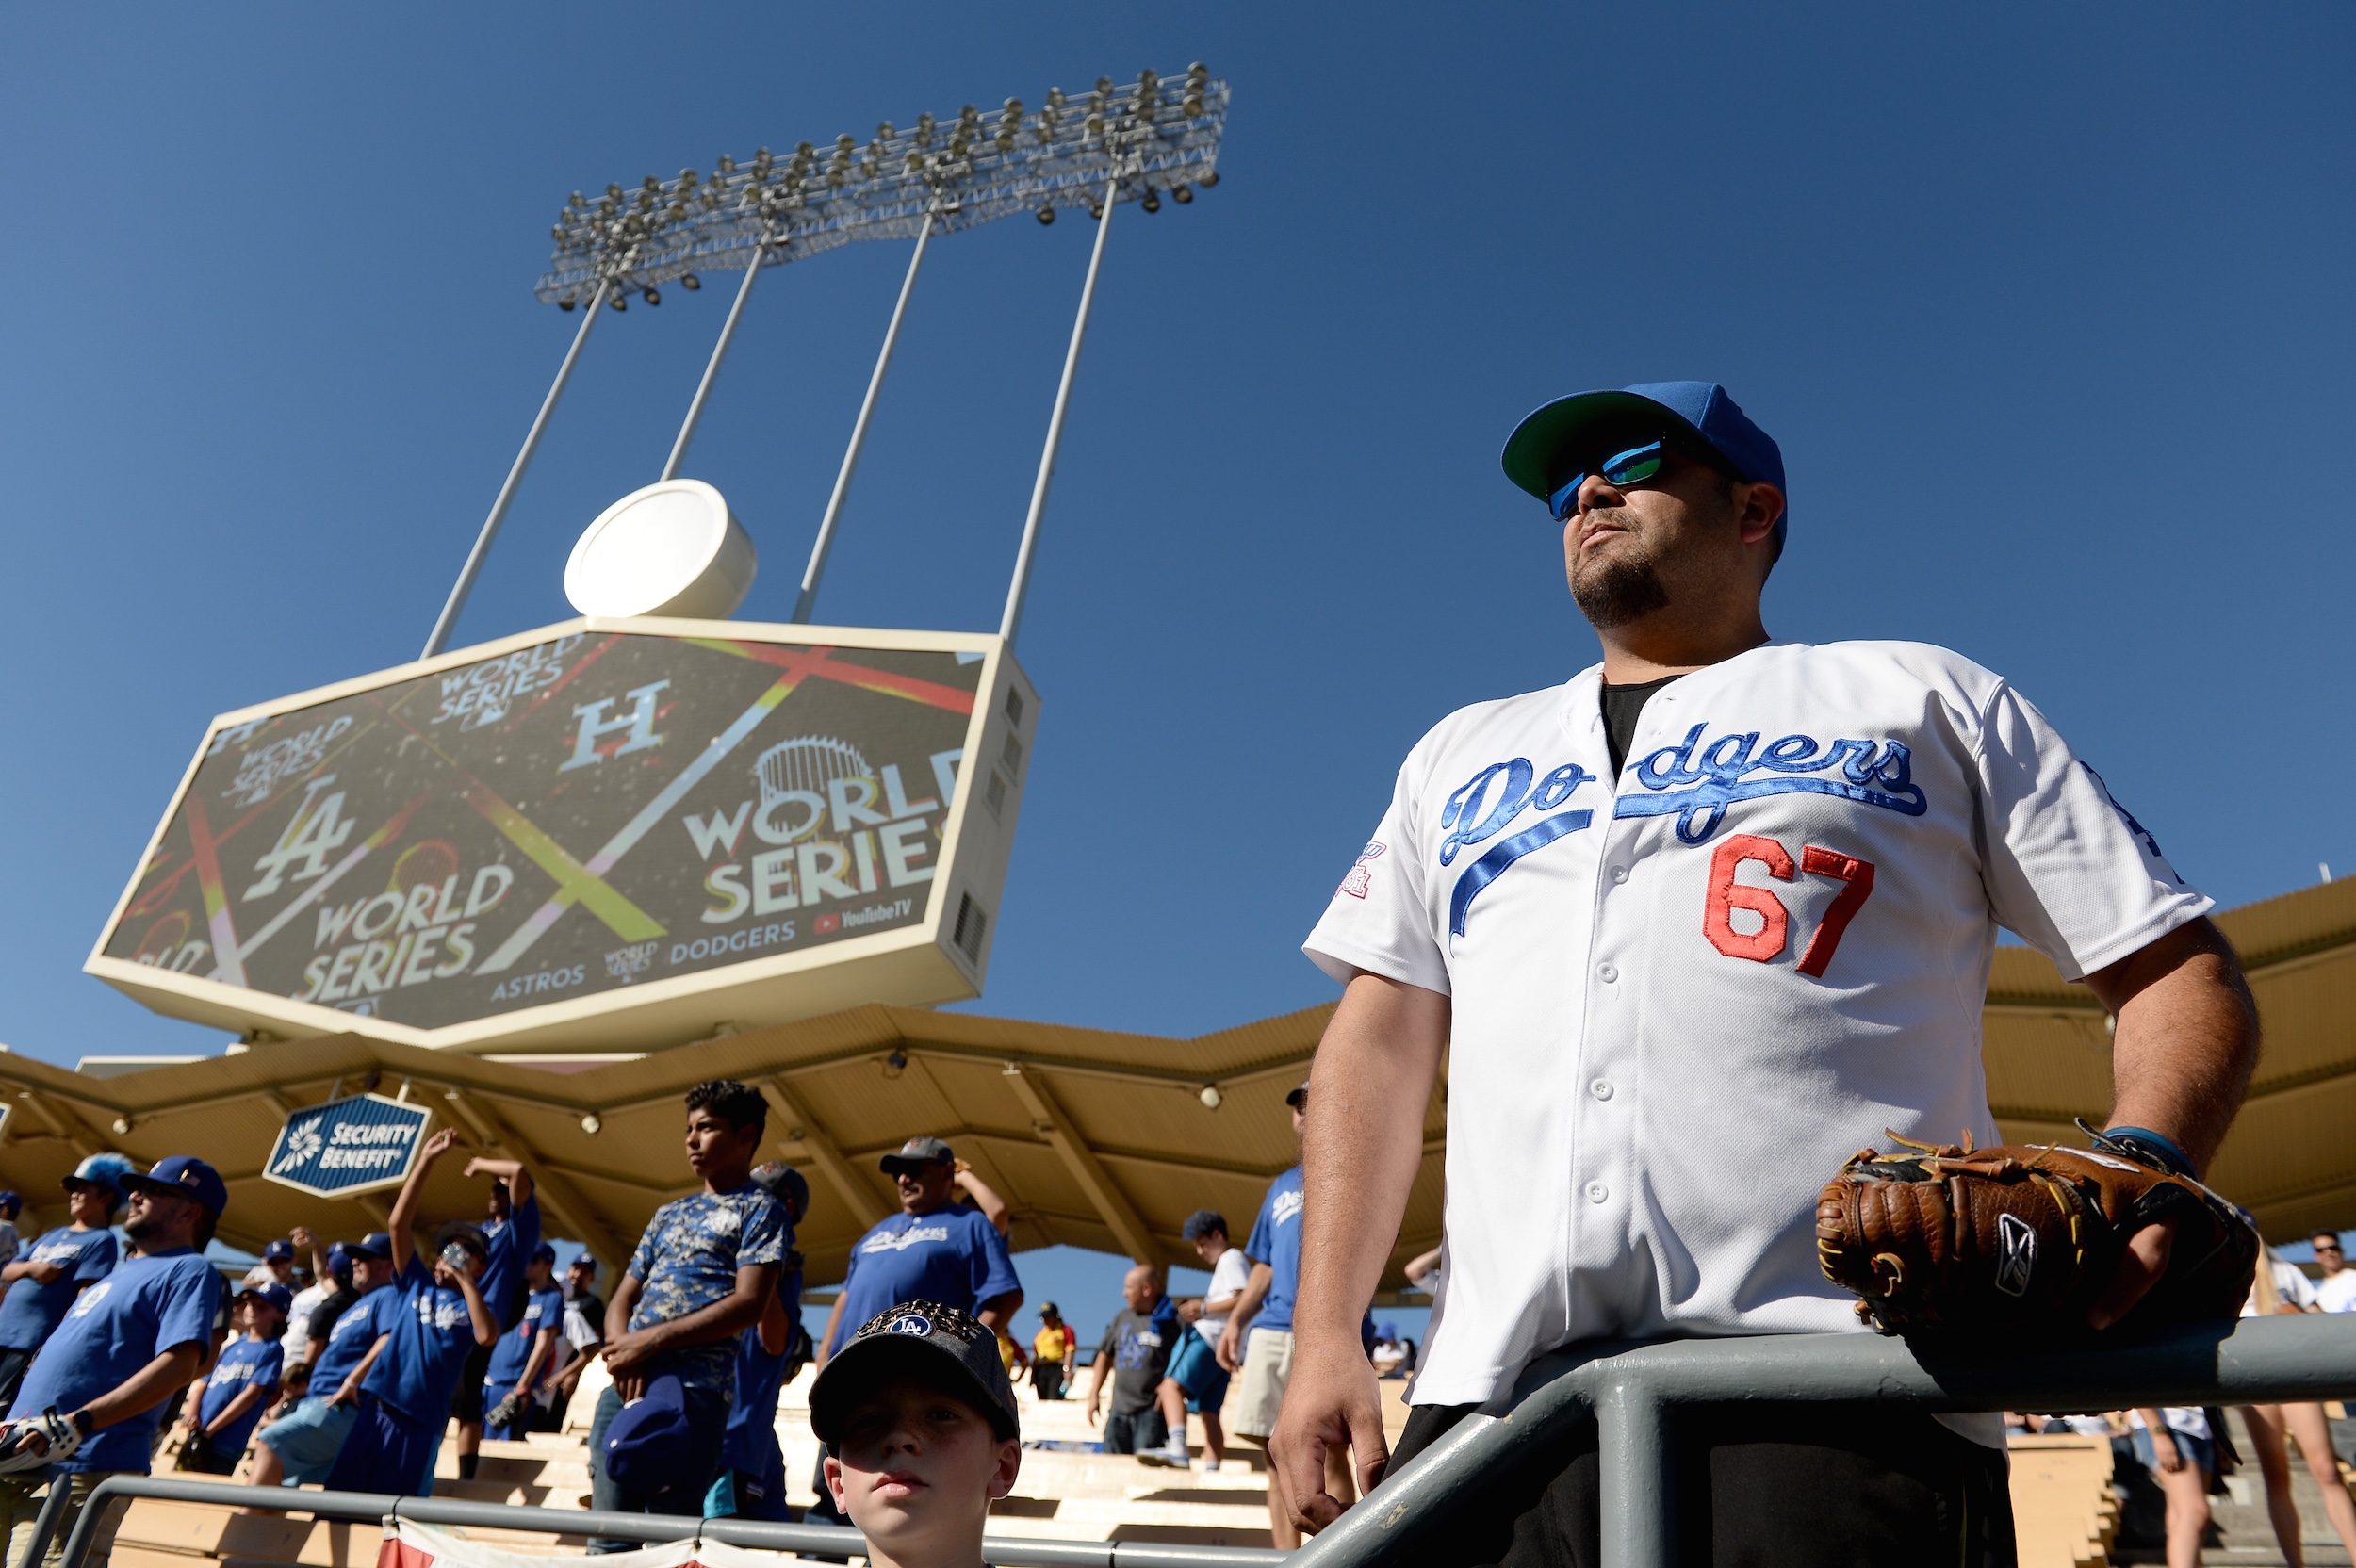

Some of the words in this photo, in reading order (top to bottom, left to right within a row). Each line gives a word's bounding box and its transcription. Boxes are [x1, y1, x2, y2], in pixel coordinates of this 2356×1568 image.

[430, 659, 564, 726] SERIES
[441, 633, 586, 697] WORLD
[221, 748, 326, 798] SERIES
[239, 715, 353, 771] WORLD
[1439, 722, 1927, 867] Dodgers
[700, 816, 947, 924] SERIE
[314, 863, 515, 950] WORLD
[1702, 834, 1875, 978] 67
[290, 923, 477, 1003] SERIES
[670, 921, 796, 964] DODGERS
[490, 964, 586, 1002] ASTROS
